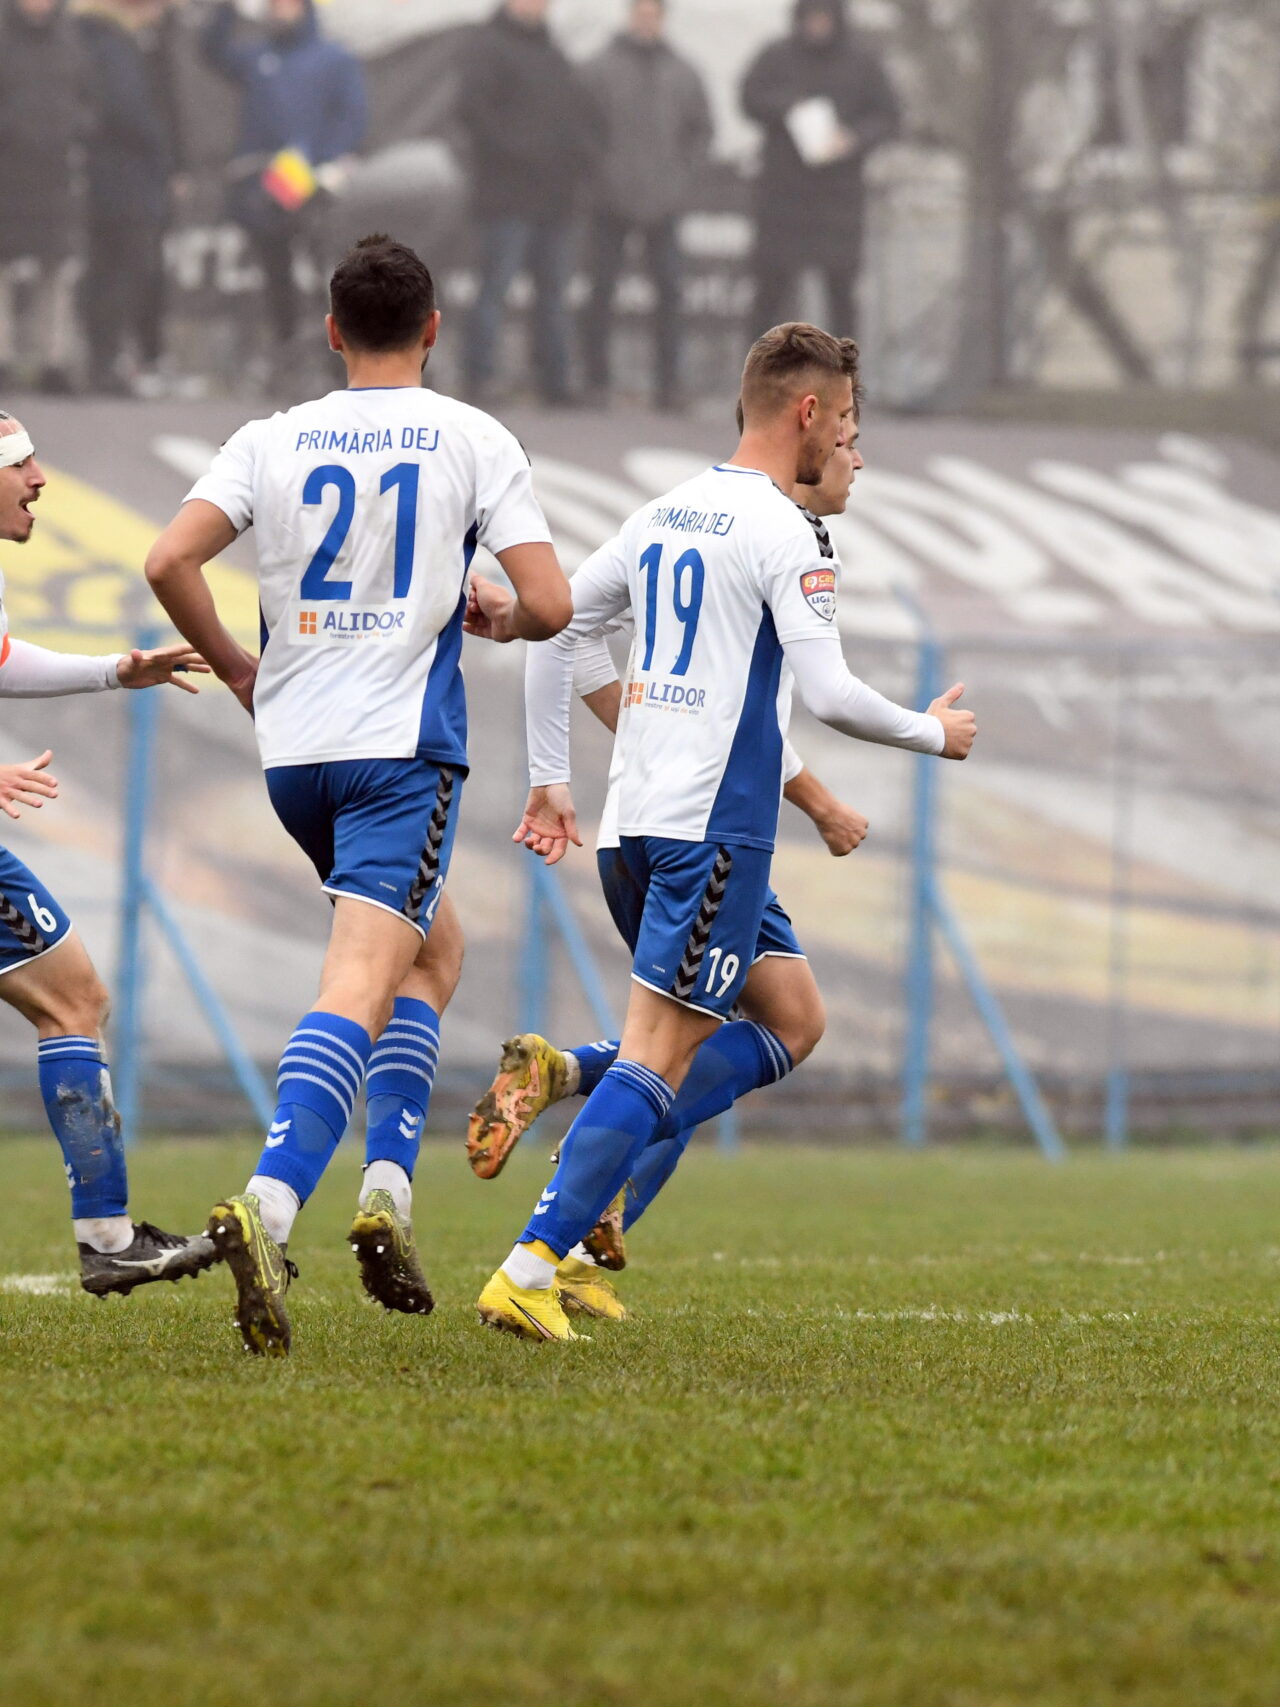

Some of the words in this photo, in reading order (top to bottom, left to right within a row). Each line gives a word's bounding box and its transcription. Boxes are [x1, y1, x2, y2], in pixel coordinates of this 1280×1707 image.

[295, 427, 393, 454] PRIMĂRIA
[400, 426, 440, 452] DEJ
[300, 462, 420, 601] 21
[704, 512, 735, 536] DEJ
[323, 610, 406, 631] ALIDOR
[638, 542, 706, 677] 19
[645, 681, 707, 708] LIDOR
[27, 892, 57, 933] 6
[704, 946, 740, 999] 19
